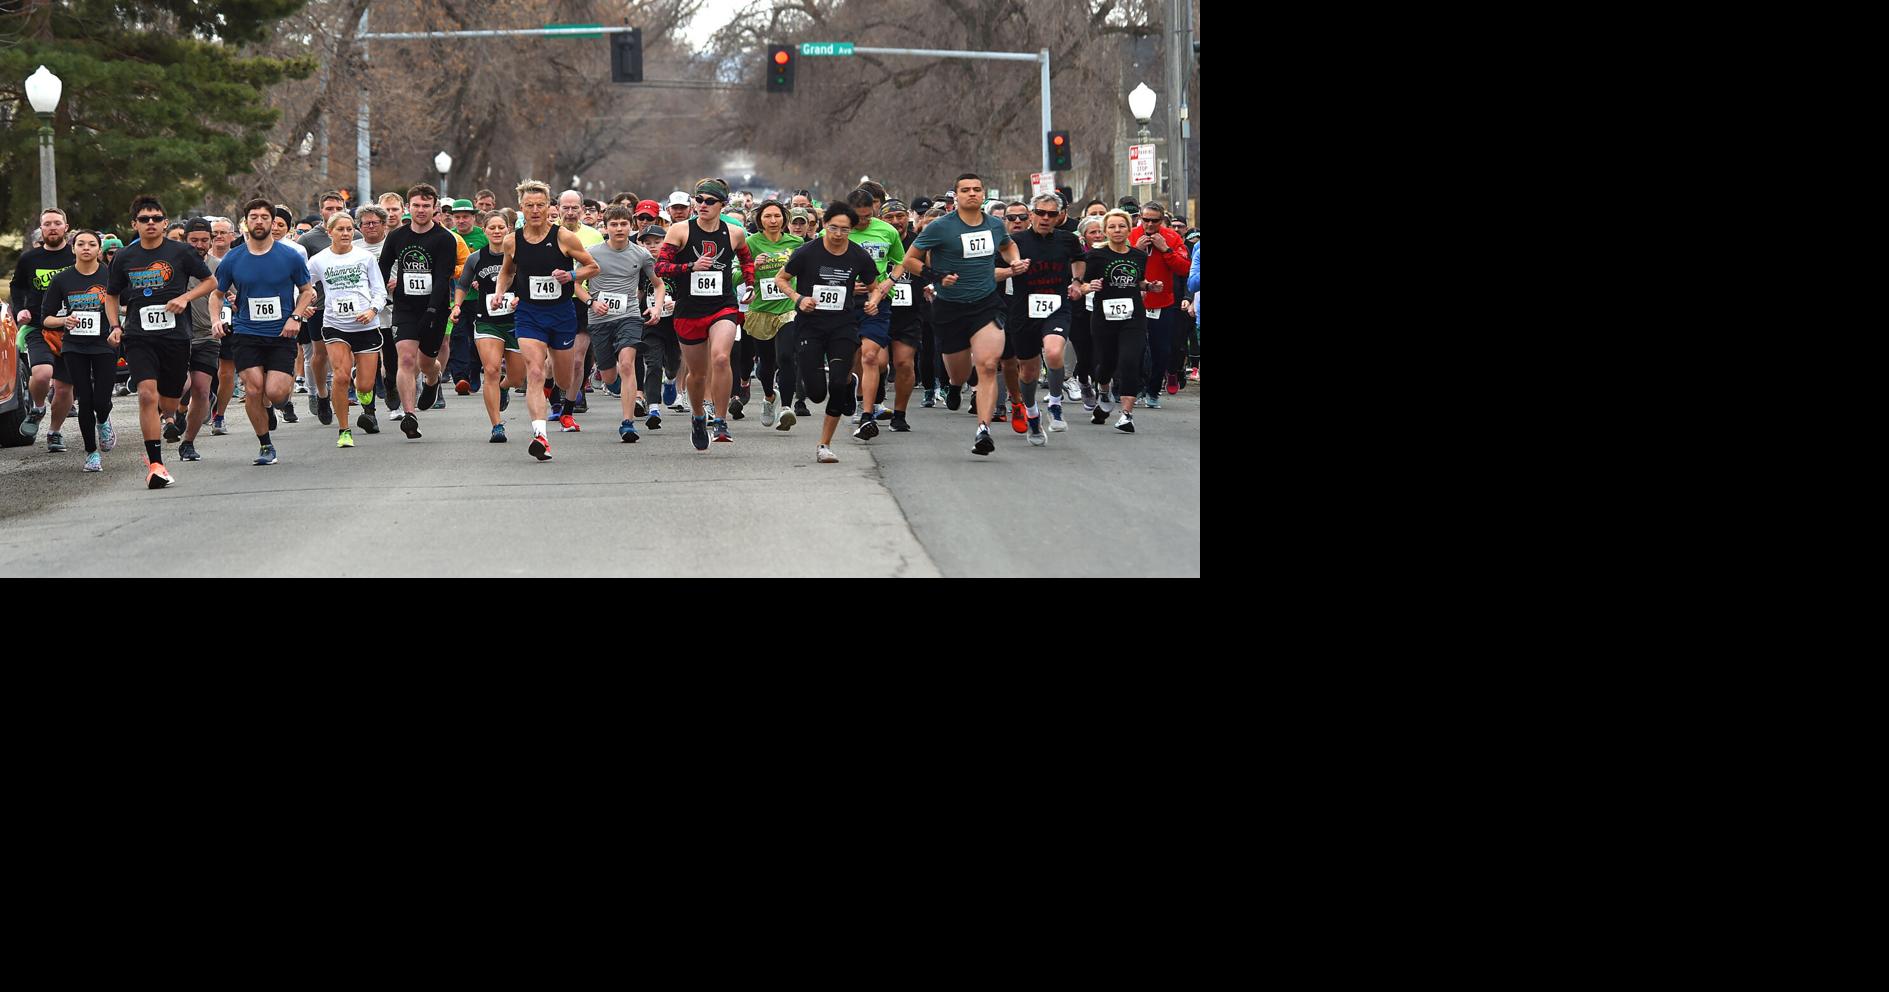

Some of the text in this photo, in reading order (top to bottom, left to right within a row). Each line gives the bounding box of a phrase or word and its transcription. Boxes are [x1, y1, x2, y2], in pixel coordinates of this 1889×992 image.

[803, 43, 852, 55] Grand Ave
[970, 238, 986, 251] 677
[405, 261, 426, 270] YRR
[324, 264, 362, 279] Shamrock
[409, 279, 426, 290] 611
[698, 278, 716, 289] 684
[1113, 275, 1134, 284] YRR
[536, 282, 555, 293] 748
[820, 292, 839, 304] 589
[255, 304, 274, 315] 768
[337, 302, 354, 313] 784
[1036, 301, 1053, 312] 754
[1110, 304, 1128, 315] 762
[148, 312, 168, 323] 671
